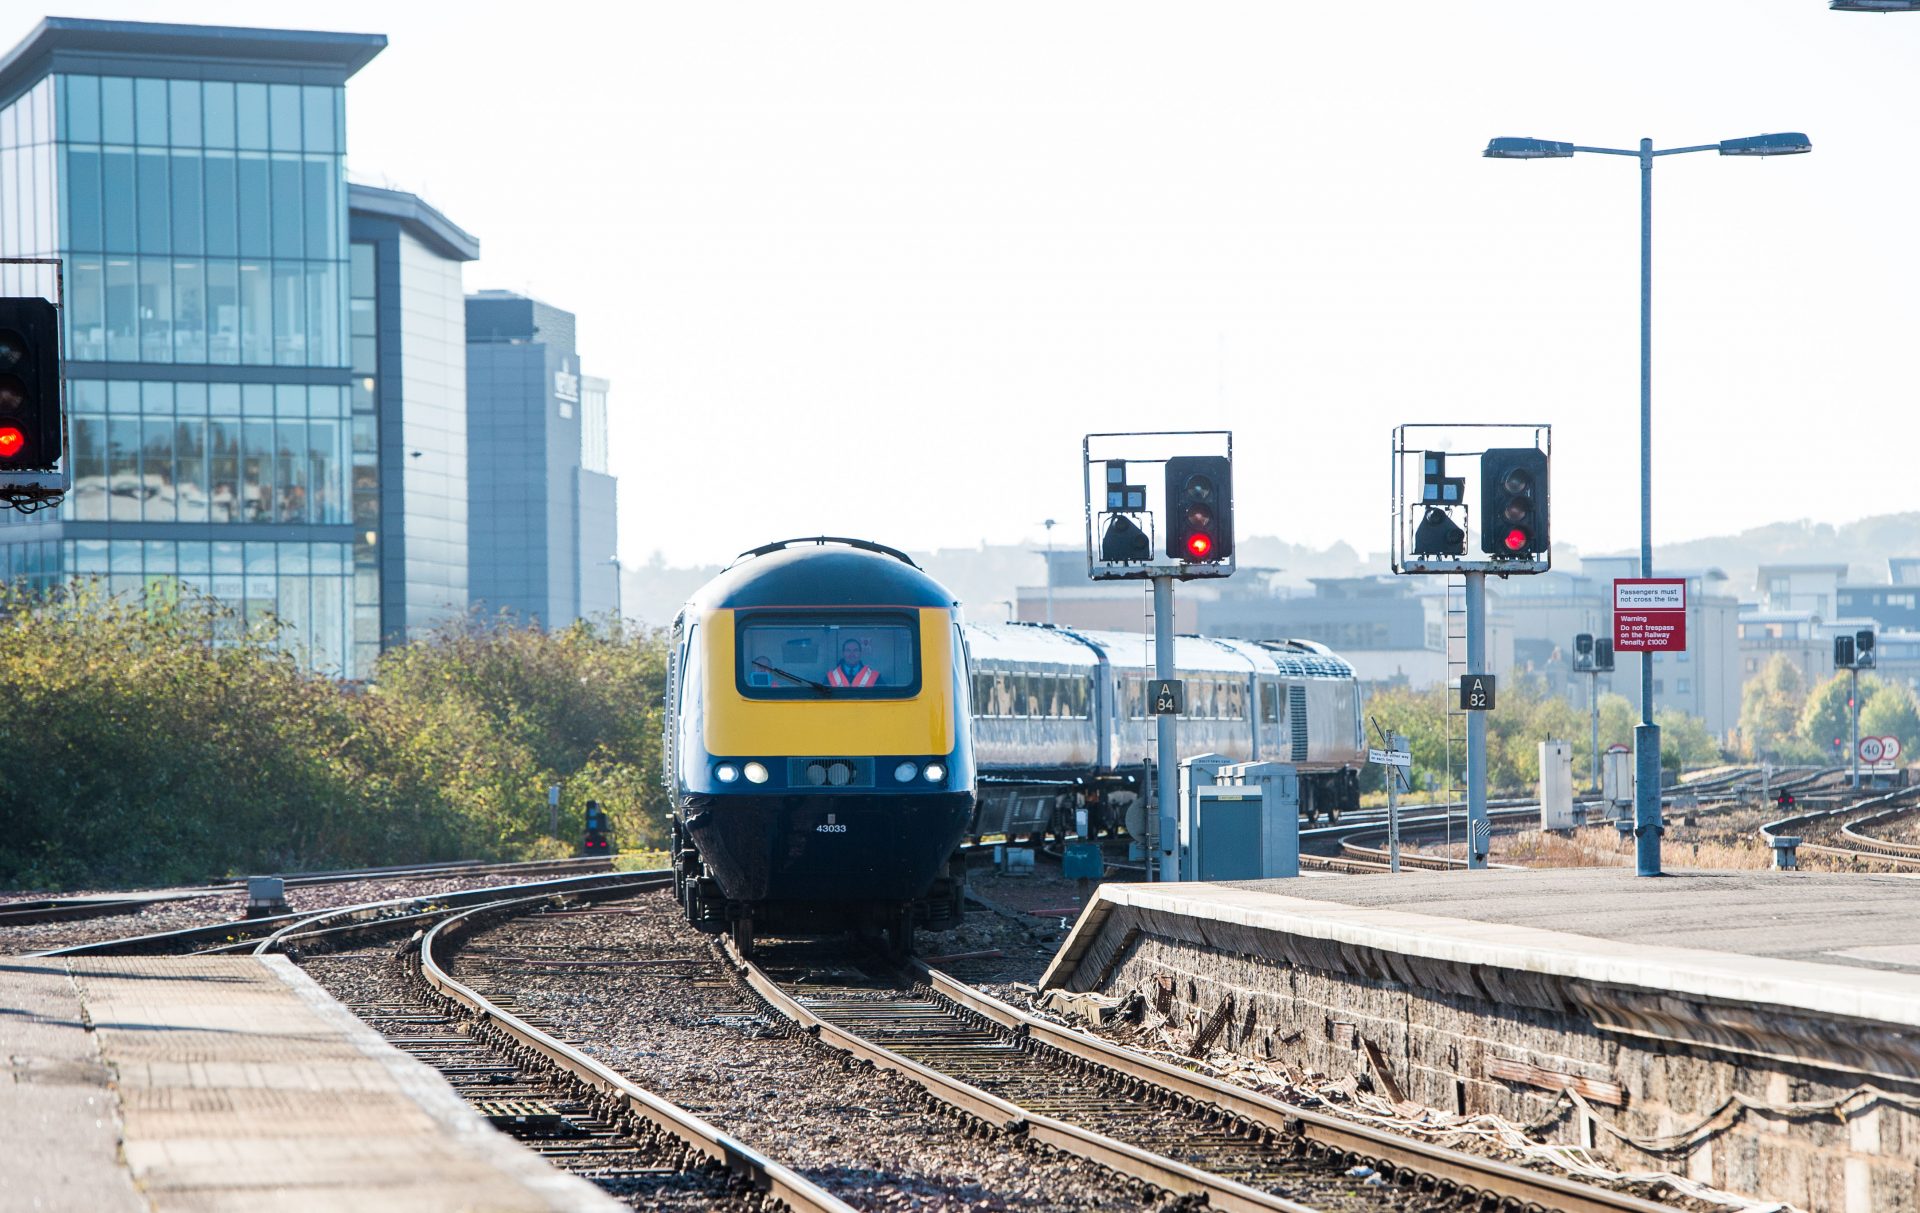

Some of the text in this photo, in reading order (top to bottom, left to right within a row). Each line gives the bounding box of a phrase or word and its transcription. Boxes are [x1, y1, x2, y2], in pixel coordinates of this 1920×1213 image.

[1161, 683, 1170, 695] A
[1473, 678, 1483, 690] A
[1157, 698, 1174, 710] 84
[1470, 693, 1486, 706] 82
[1864, 744, 1879, 755] 40
[816, 824, 847, 833] 43033
